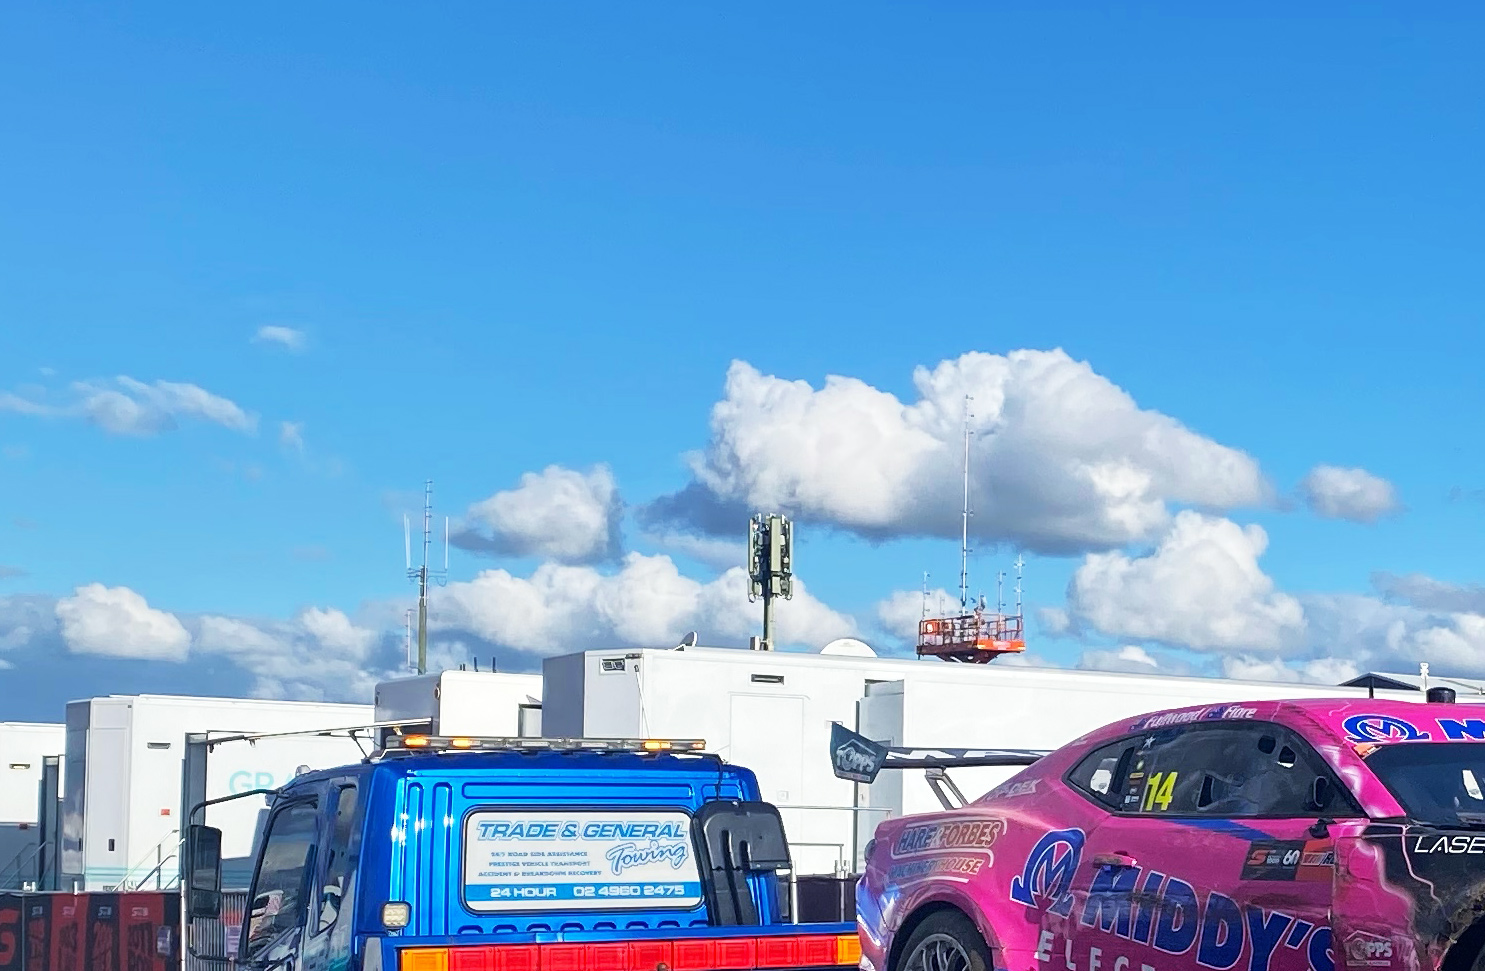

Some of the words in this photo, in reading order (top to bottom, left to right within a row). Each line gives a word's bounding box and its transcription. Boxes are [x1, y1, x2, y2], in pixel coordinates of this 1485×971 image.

[1222, 705, 1257, 718] Fiore
[1145, 772, 1178, 811] 14
[478, 820, 559, 841] TRADE
[560, 821, 579, 840] &
[582, 820, 687, 840] GENERAL
[606, 840, 688, 875] Towing
[490, 888, 511, 898] 24
[514, 887, 557, 897] HOUR
[573, 886, 595, 896] 02
[598, 886, 640, 896] 4960
[644, 885, 685, 895] 2475
